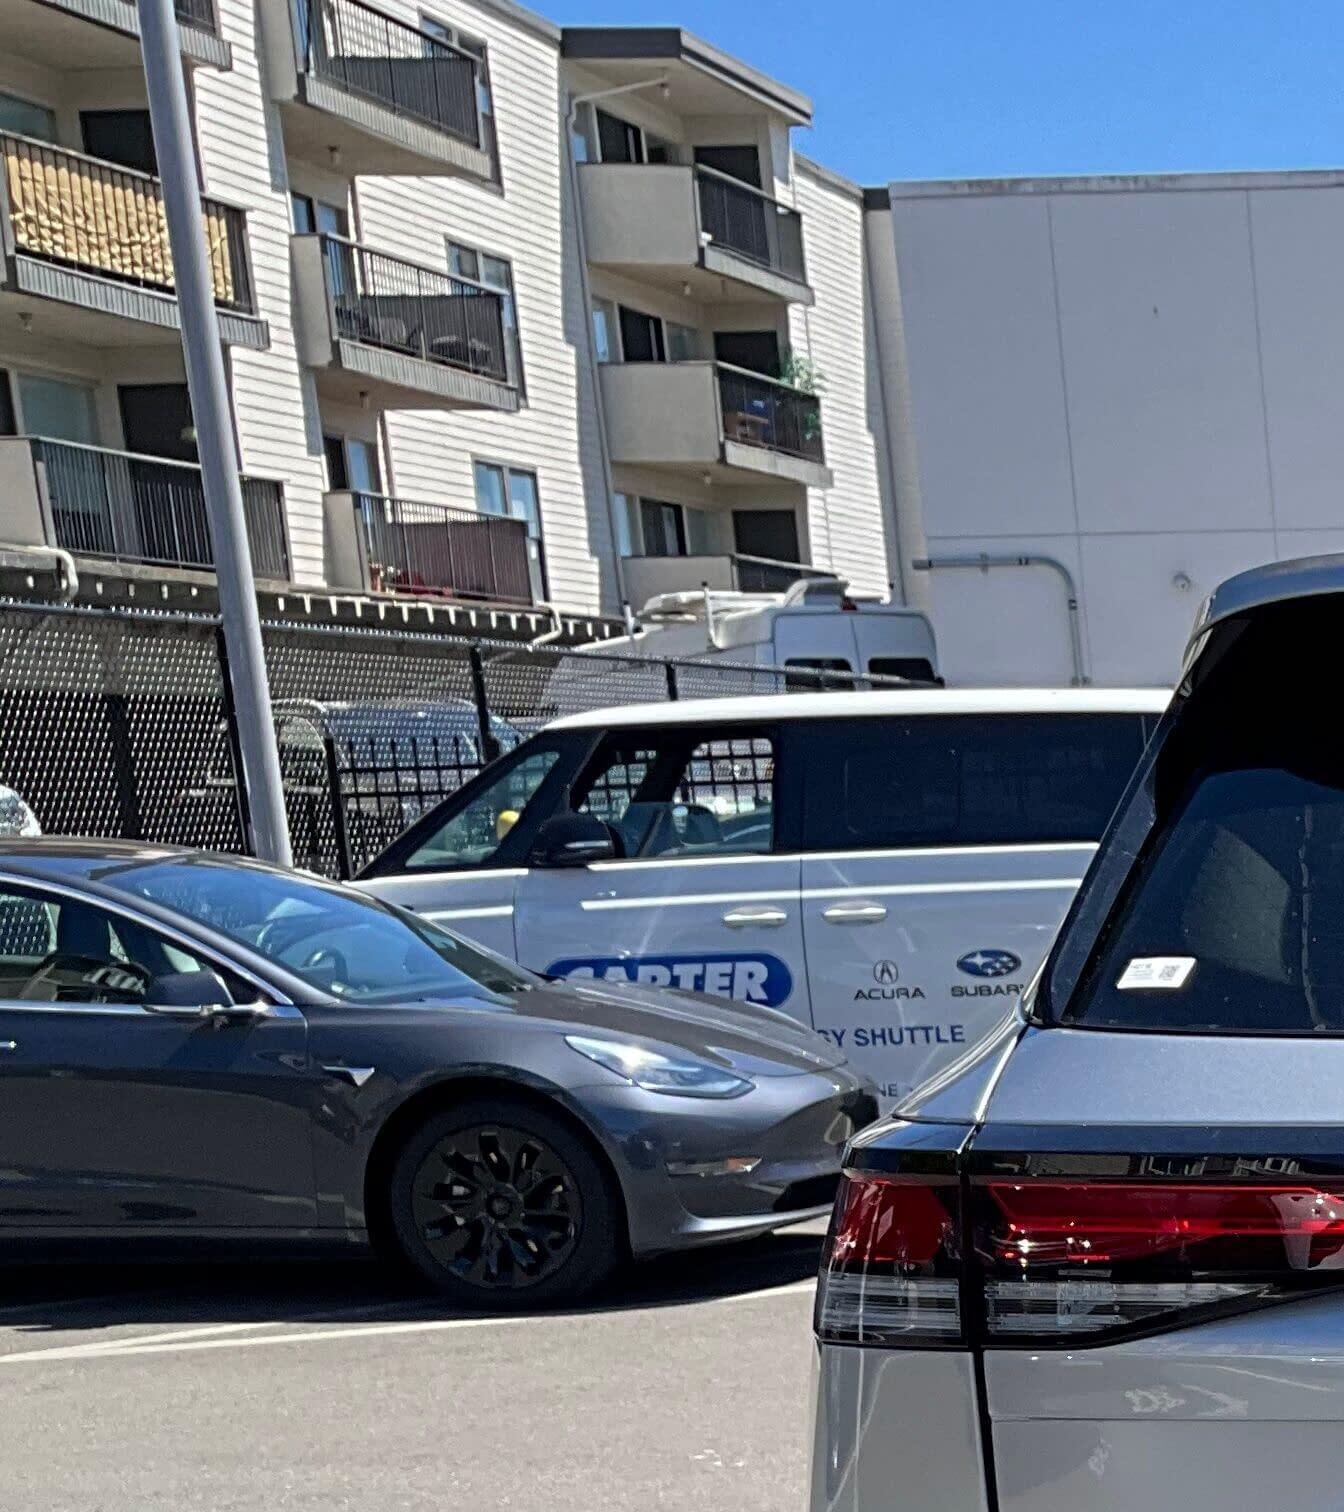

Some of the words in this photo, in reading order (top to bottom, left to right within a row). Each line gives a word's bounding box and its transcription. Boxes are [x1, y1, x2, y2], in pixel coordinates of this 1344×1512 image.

[854, 986, 926, 1001] ACURA
[951, 984, 1024, 998] SUBAR
[854, 1025, 966, 1048] SHUTTLE
